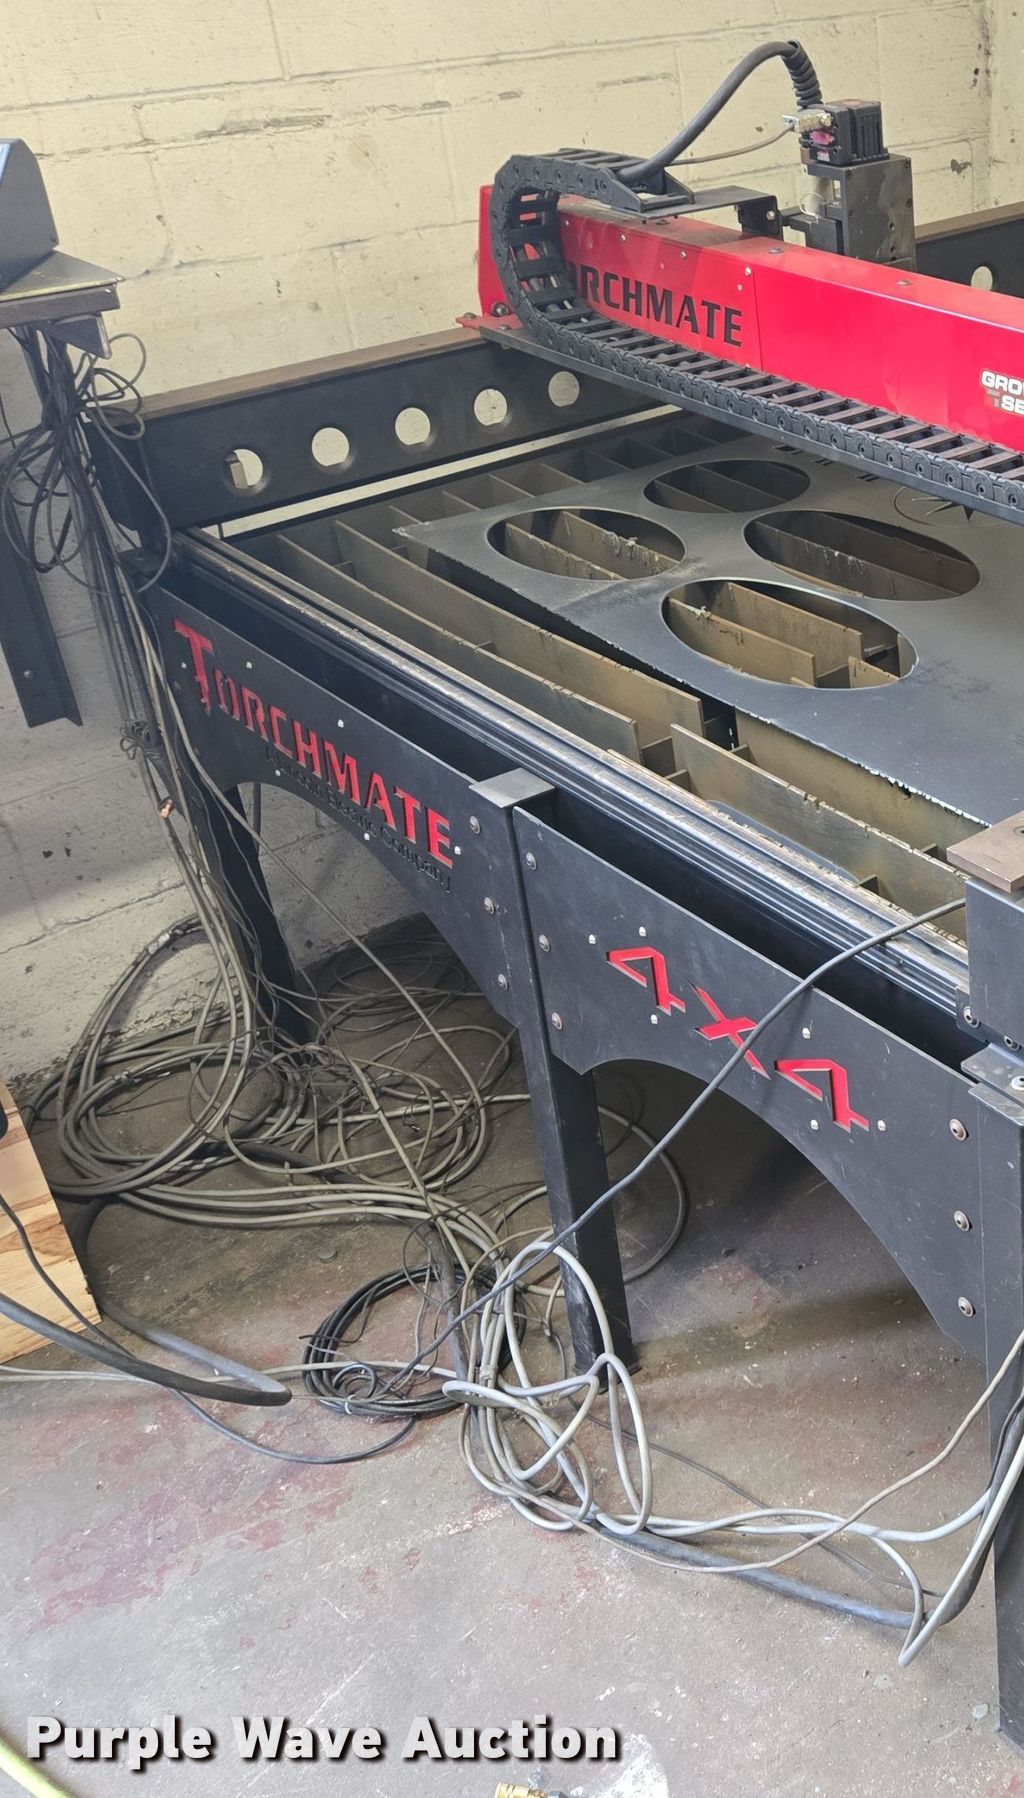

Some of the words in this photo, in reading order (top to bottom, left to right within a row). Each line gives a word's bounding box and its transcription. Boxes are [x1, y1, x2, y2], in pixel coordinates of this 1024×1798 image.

[567, 261, 742, 347] RCHMATE
[172, 618, 453, 869] TORCHMATE
[380, 825, 452, 894] Company
